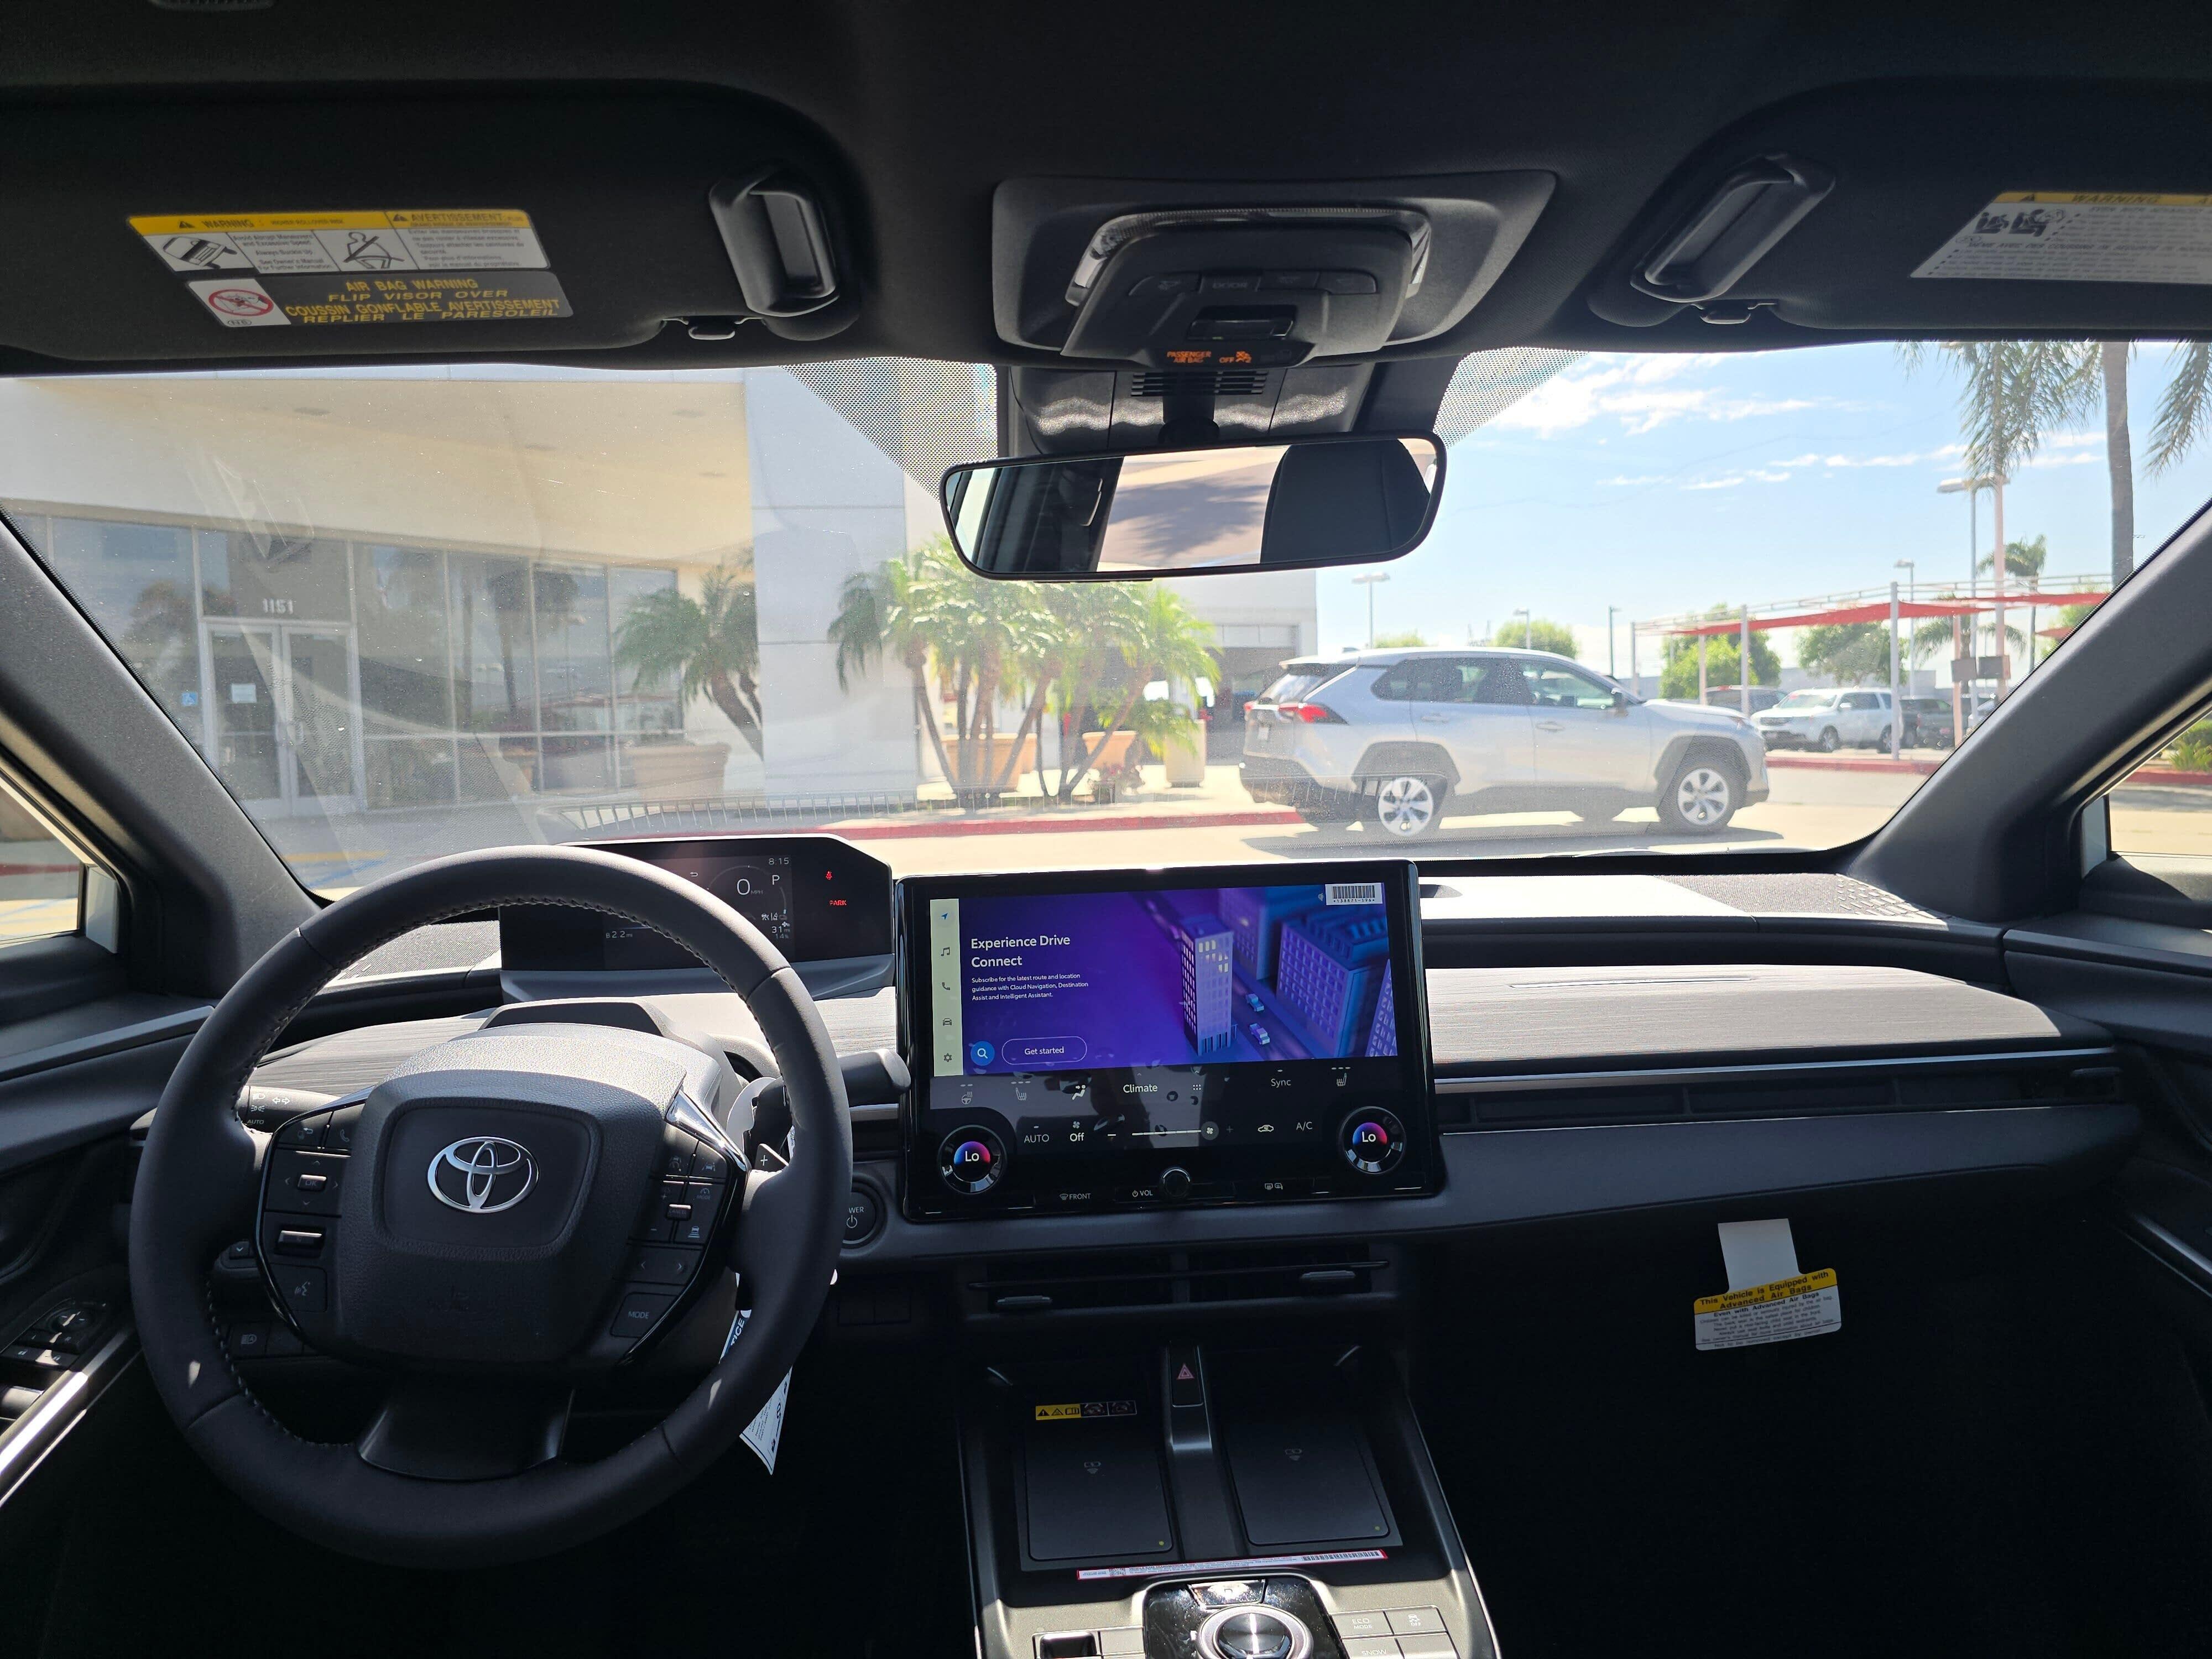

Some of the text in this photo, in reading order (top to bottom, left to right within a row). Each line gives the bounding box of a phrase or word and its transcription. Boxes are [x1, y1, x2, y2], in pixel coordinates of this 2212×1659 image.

[411, 213, 502, 222] AVERTISSEMENT
[346, 278, 479, 291] AIR BAG WARNING
[328, 290, 508, 302] FLIP VISOR OVER
[285, 299, 560, 317] COUSSIN GONFLABLE AVERTISSEMENT
[304, 309, 558, 324] REPLIER LE PARESOLEIL
[263, 598, 293, 614] 1151
[772, 875, 780, 885] P
[971, 935, 1071, 951] Experience Drive
[971, 956, 1022, 968] Connect
[1039, 1046, 1065, 1055] started
[1123, 1083, 1159, 1093] Climate
[1271, 1078, 1291, 1089] Sync
[1296, 1121, 1313, 1131] A/C
[1024, 1134, 1050, 1143] AUTO
[1070, 1132, 1085, 1142] Off
[1361, 1131, 1376, 1142] Lo
[964, 1151, 980, 1162] Lo
[1723, 1290, 1753, 1301] Vehicle
[1768, 1276, 1808, 1291] Equipped
[1812, 1271, 1829, 1281] with
[1720, 1295, 1765, 1309] Advanced
[1789, 1284, 1812, 1295] Bags
[1752, 1299, 1786, 1310] Advanced
[628, 1311, 649, 1319] MODE
[730, 1318, 745, 1346] TICE
